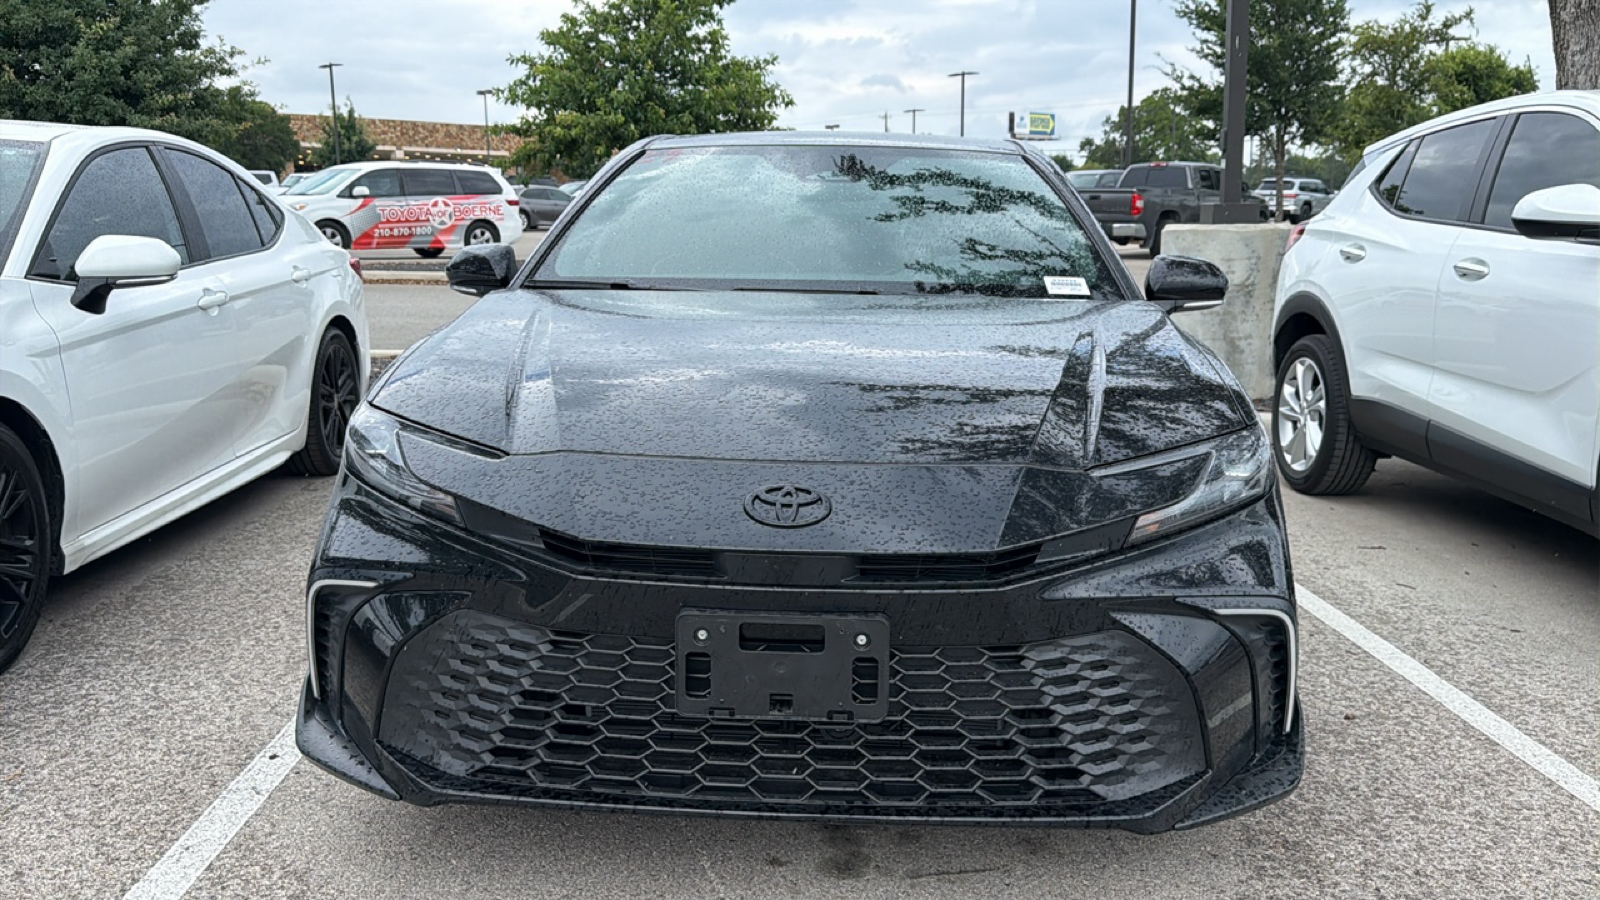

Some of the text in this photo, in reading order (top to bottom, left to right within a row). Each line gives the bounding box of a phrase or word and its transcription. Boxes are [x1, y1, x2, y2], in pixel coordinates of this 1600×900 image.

[378, 204, 504, 222] TOYOTA OF BOERNE
[374, 226, 432, 237] 210-870-1800
